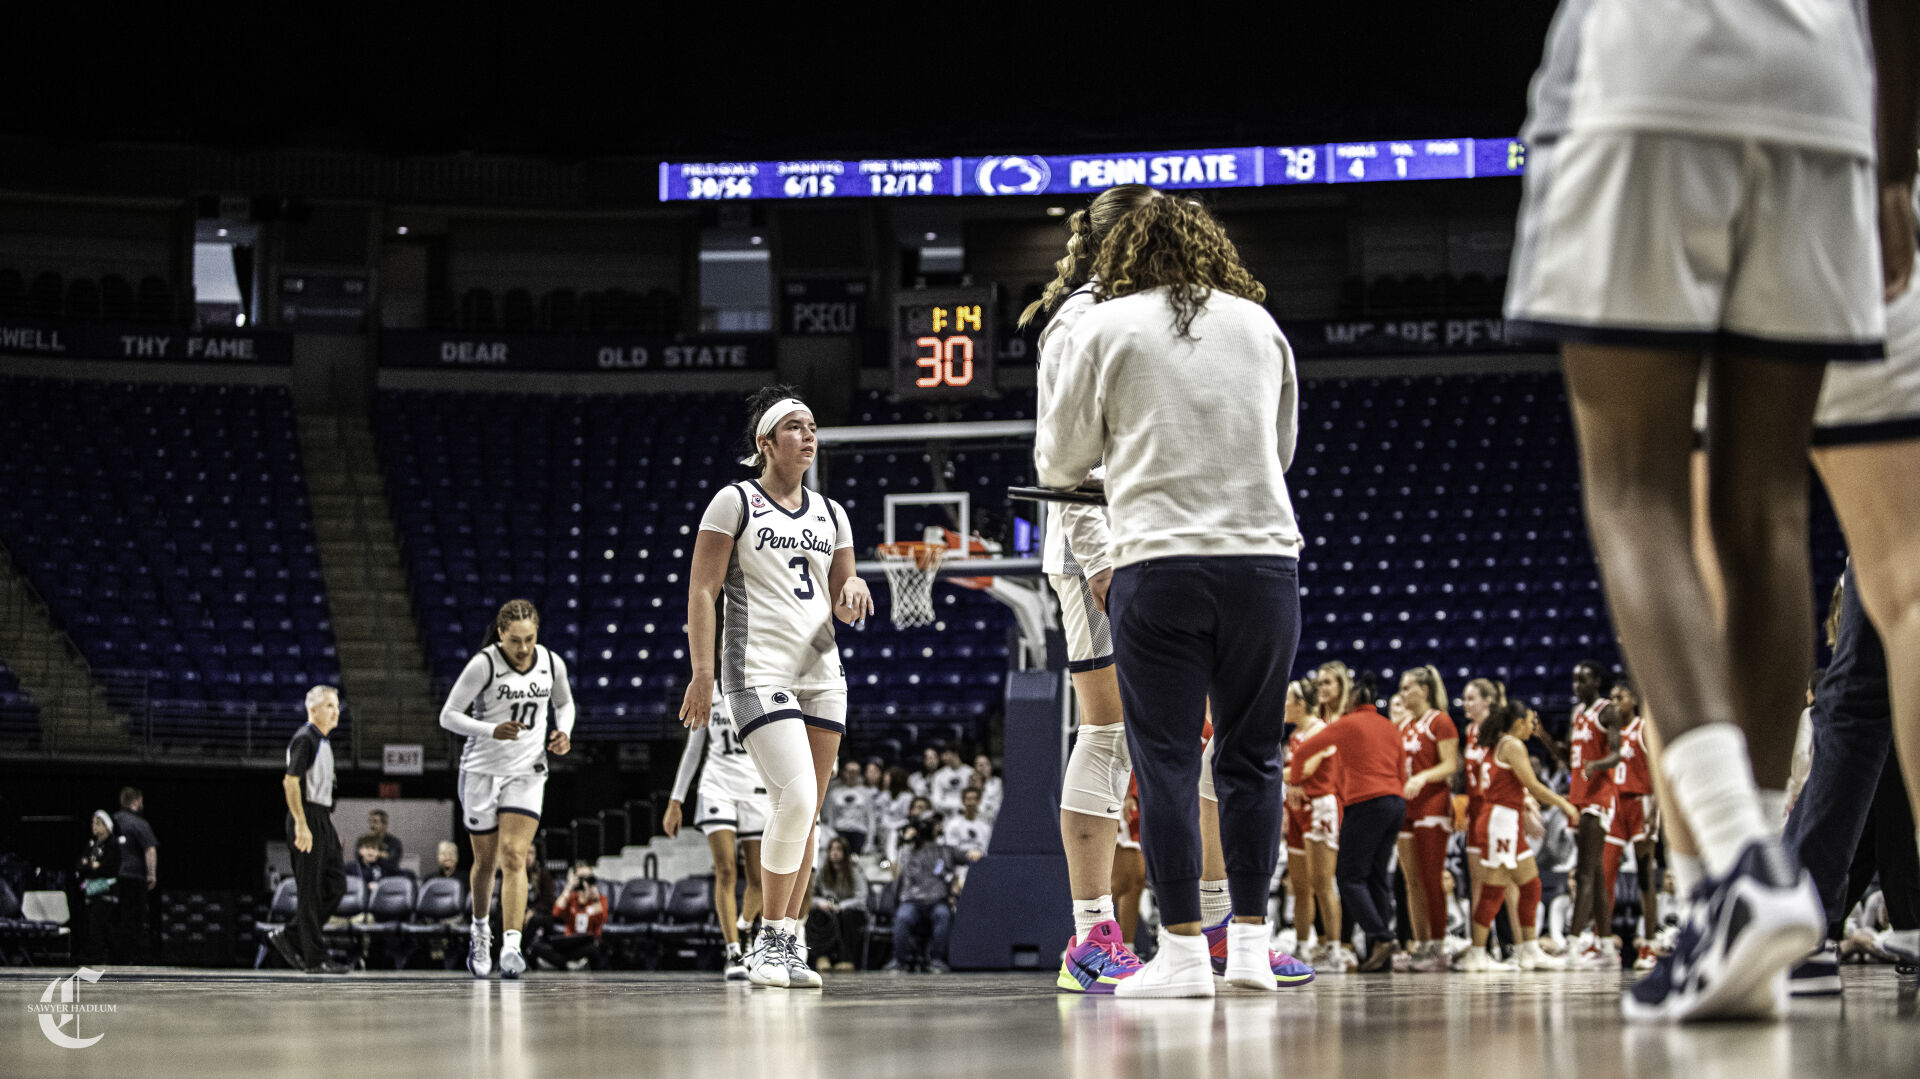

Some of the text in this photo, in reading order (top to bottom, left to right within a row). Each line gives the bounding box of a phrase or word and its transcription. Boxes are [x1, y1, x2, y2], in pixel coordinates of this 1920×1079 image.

[1070, 154, 1238, 188] PENN STATE
[1348, 157, 1365, 179] 4
[1395, 157, 1407, 178] 1
[687, 176, 752, 200] 30/56
[784, 174, 836, 198] 6/15
[869, 172, 934, 197] 12/14
[932, 305, 982, 333] 1:14
[0, 327, 66, 351] WELL
[121, 335, 254, 359] THY FAME
[441, 341, 508, 363] DEAR
[598, 345, 747, 367] OLD STATE
[916, 335, 974, 388] 30
[755, 527, 832, 556] Penn State
[788, 556, 815, 600] 3
[496, 684, 525, 700] Penn
[510, 701, 538, 730] 10
[1496, 839, 1510, 853] N
